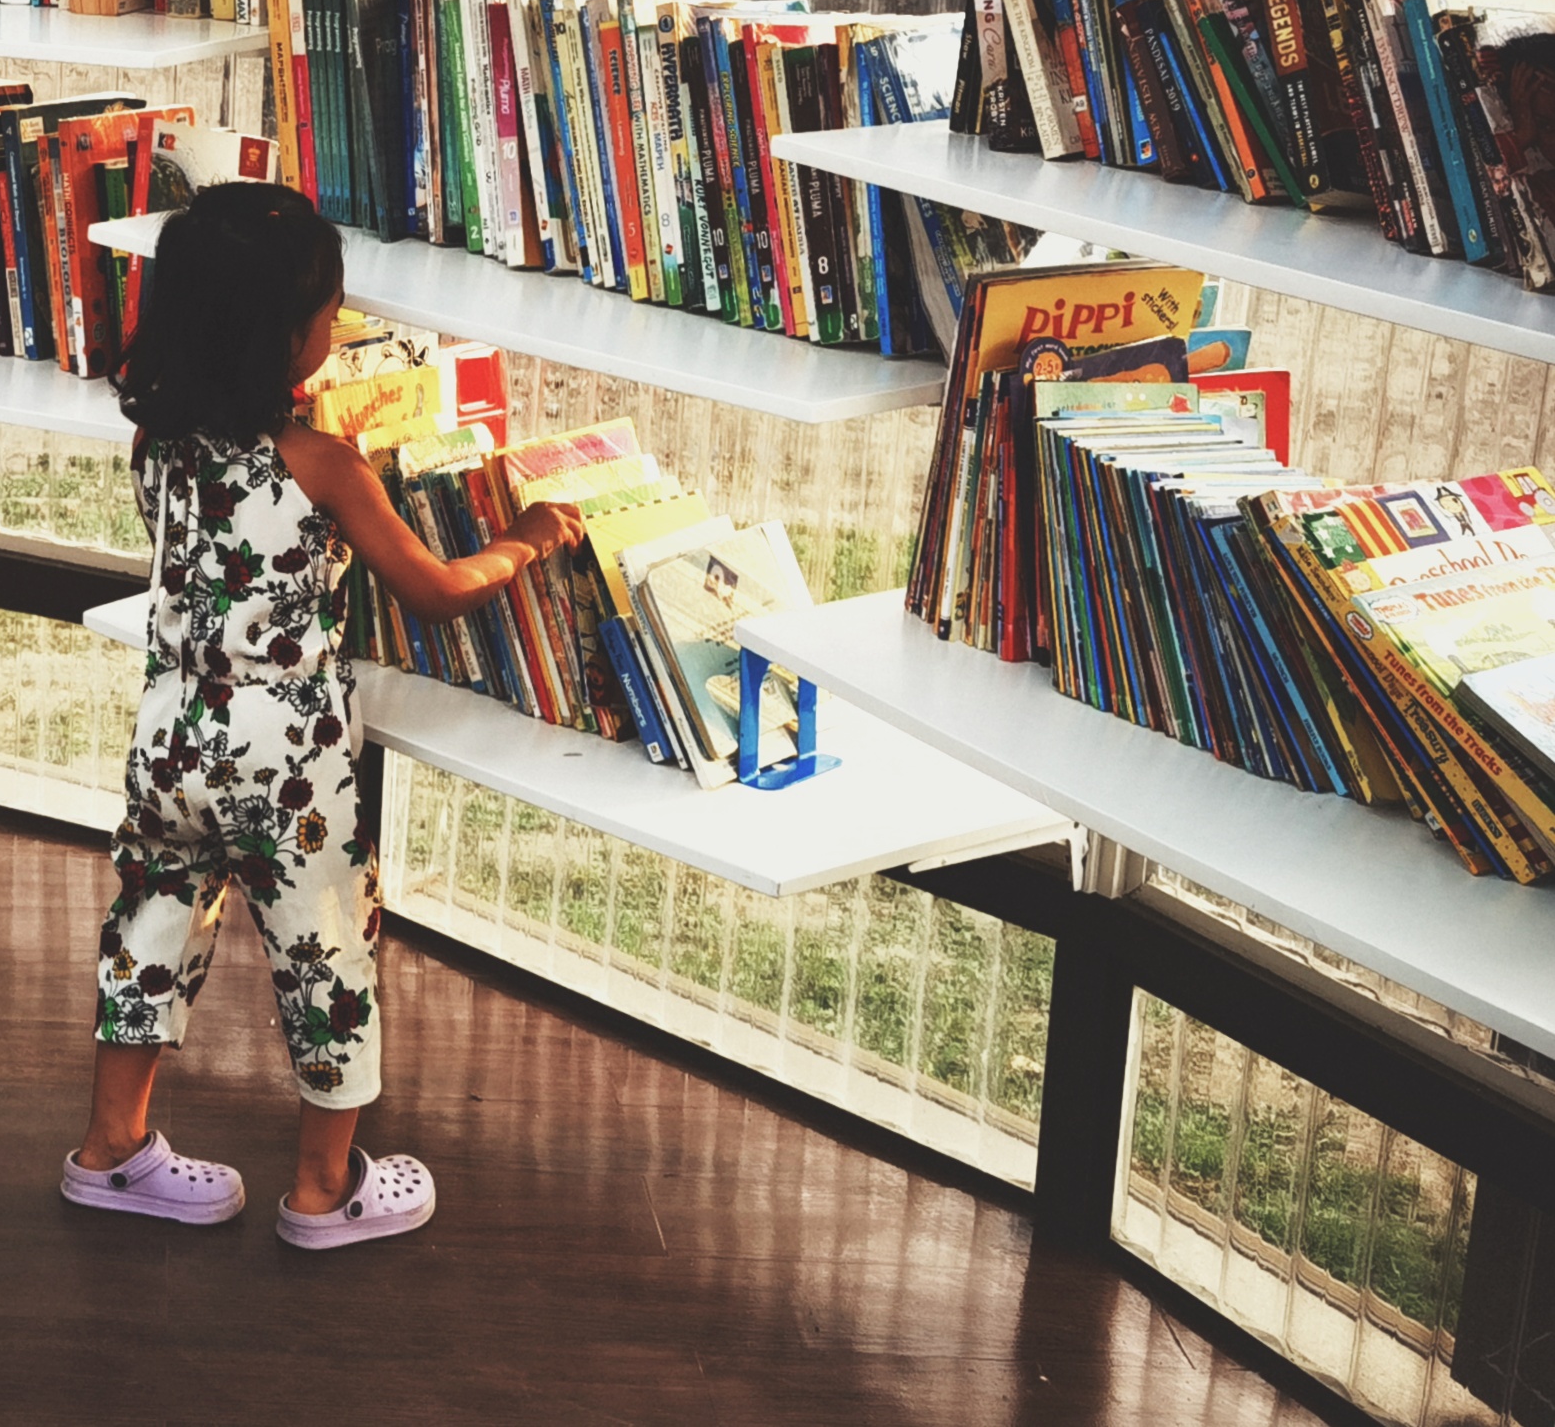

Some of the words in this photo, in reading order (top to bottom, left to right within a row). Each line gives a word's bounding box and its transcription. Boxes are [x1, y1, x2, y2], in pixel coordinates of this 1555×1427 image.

[661, 42, 683, 141] HYPERMATH
[59, 227, 73, 310] BIOLOGY
[1157, 287, 1180, 315] With
[621, 672, 648, 729] Numbers
[1381, 649, 1418, 688] Tunes
[1416, 682, 1446, 718] from
[1444, 712, 1467, 737] the
[1462, 733, 1503, 776] Tracks
